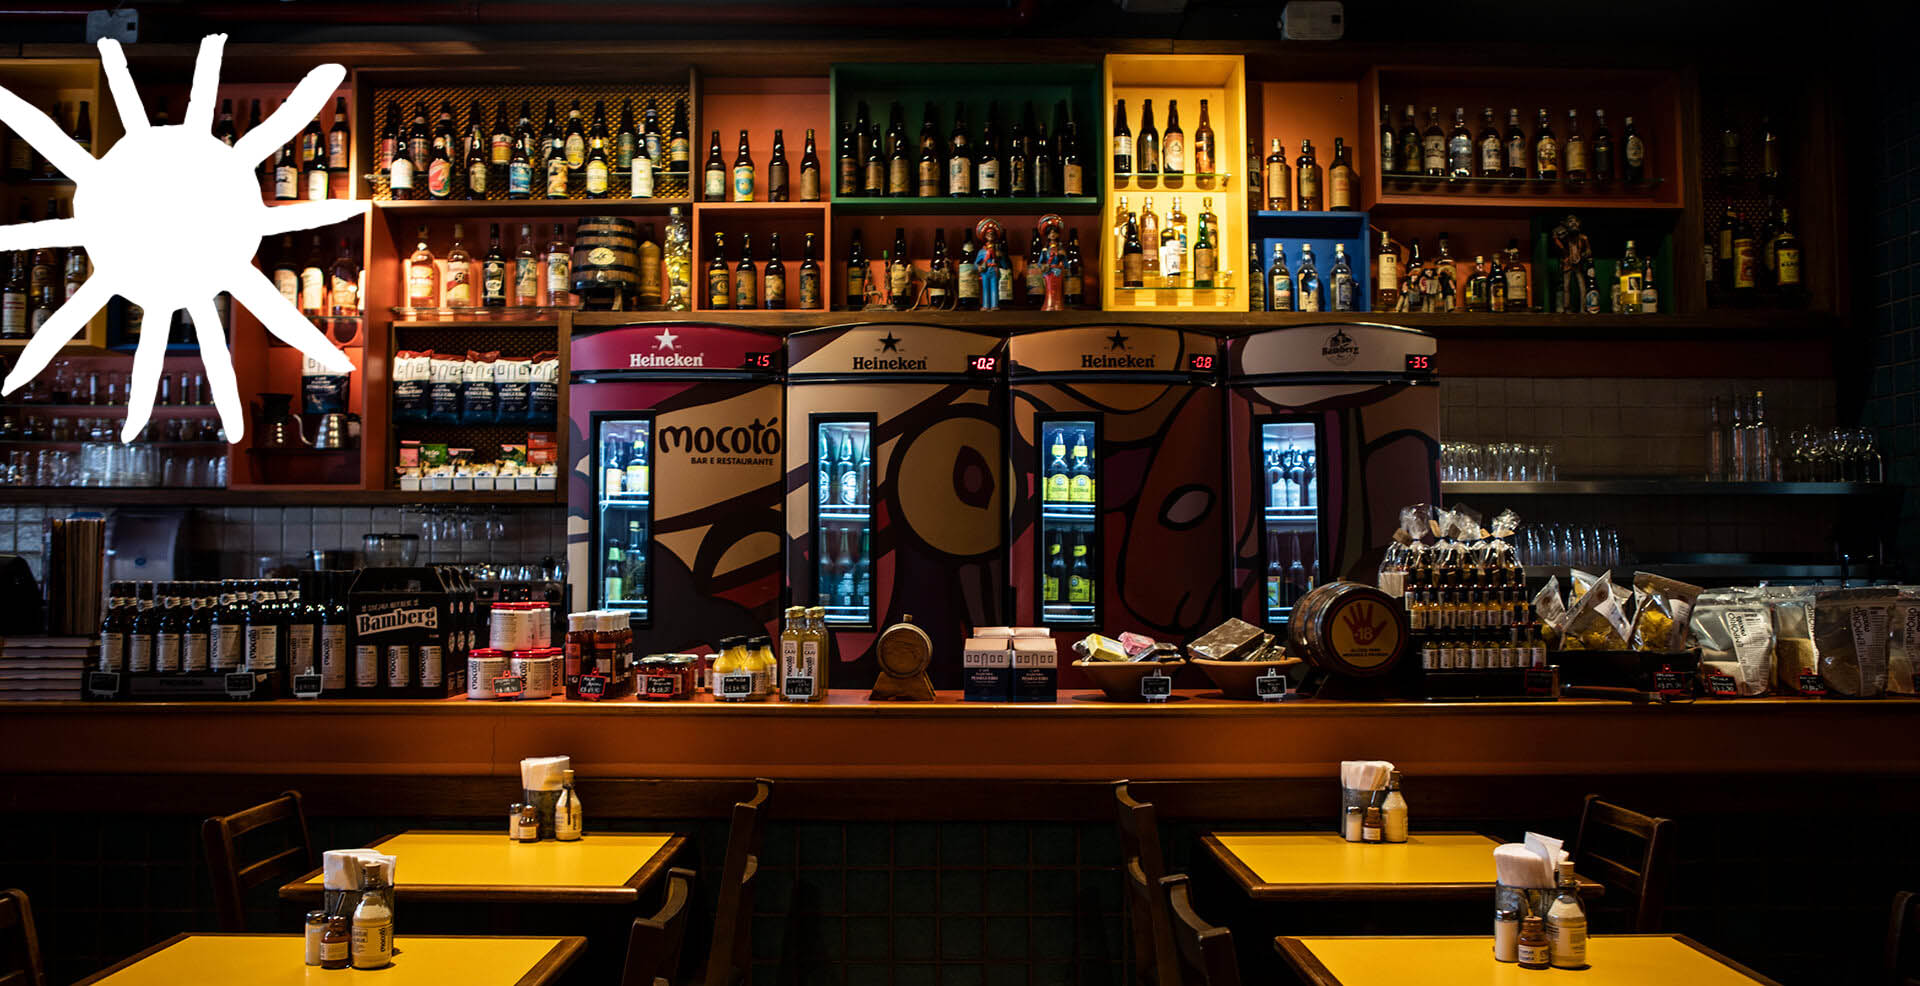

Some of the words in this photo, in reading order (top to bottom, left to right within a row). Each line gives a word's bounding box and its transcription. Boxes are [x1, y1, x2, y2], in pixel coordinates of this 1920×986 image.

[629, 352, 704, 367] Heineken
[852, 356, 927, 370] Heineken
[1081, 354, 1155, 369] Heineken
[658, 416, 780, 454] mocotó
[691, 457, 708, 465] BAR
[710, 457, 715, 465] E
[716, 457, 774, 466] RESTAURANTE
[359, 608, 437, 634] Bamberg
